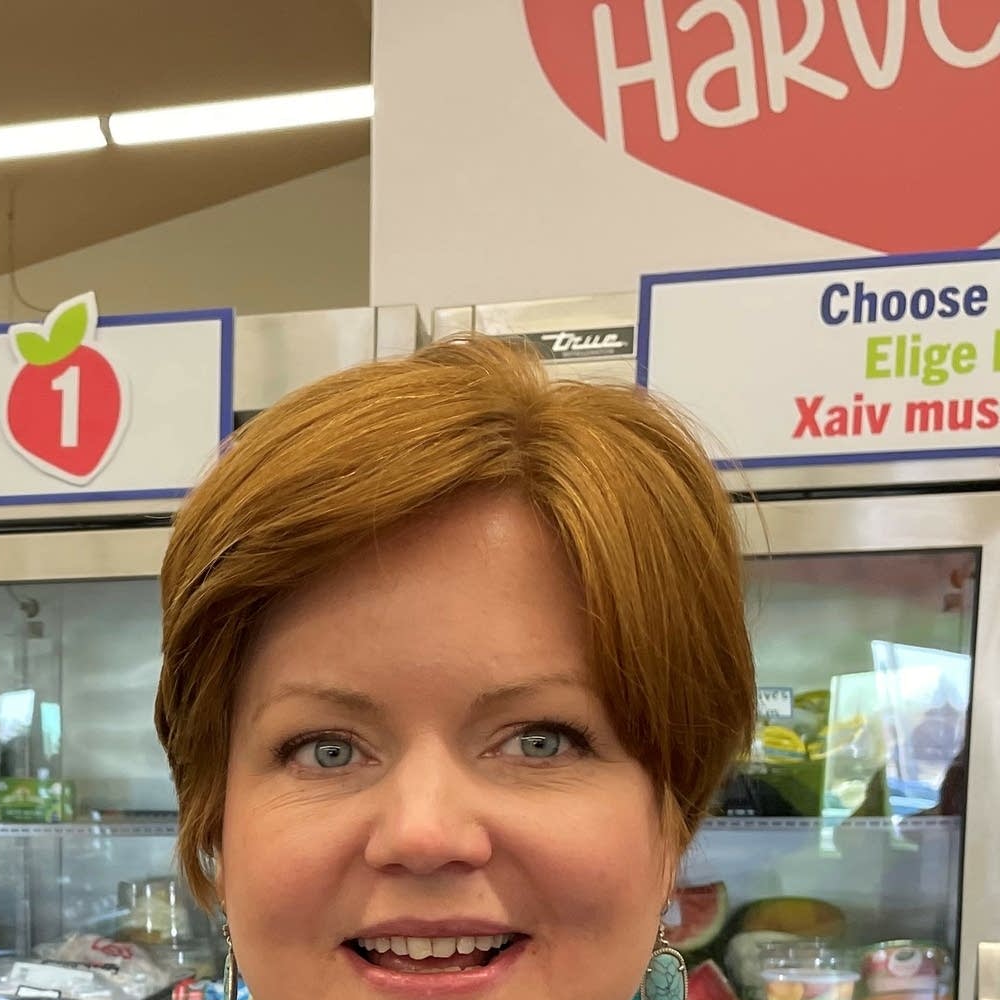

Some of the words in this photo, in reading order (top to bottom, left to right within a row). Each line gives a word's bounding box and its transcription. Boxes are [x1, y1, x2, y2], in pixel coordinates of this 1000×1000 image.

[820, 282, 988, 325] Choose
[865, 334, 978, 386] Elige
[51, 365, 80, 448] 1
[793, 393, 891, 440] Xaiv
[904, 402, 1000, 433] mus
